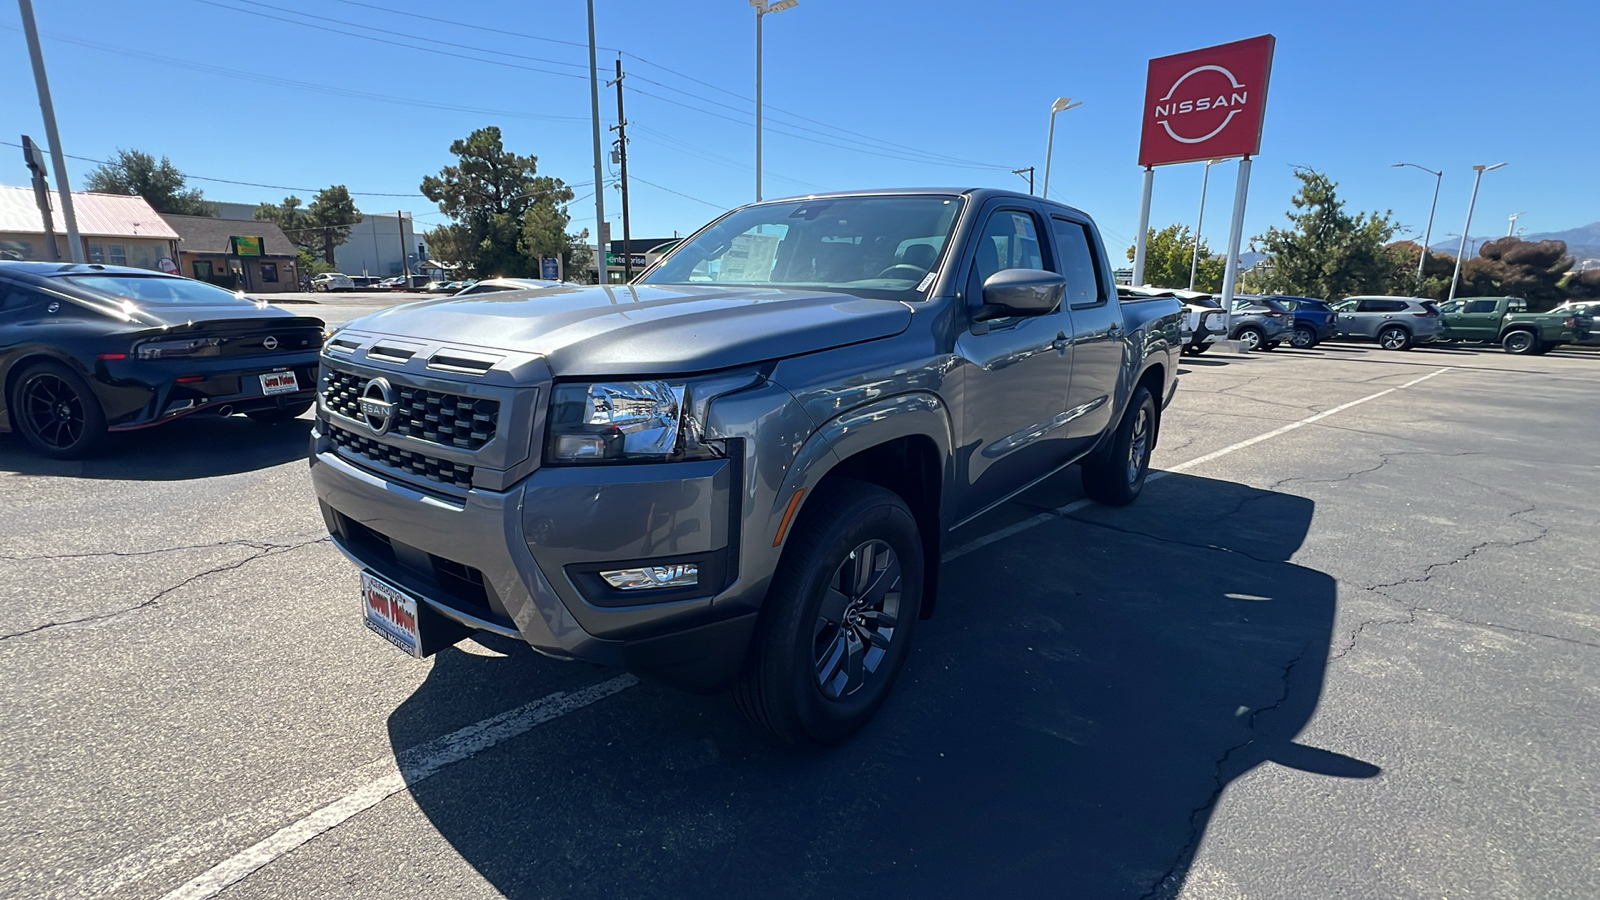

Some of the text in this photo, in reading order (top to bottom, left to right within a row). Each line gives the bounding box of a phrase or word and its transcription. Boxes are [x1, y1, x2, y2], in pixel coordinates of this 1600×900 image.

[1155, 91, 1247, 117] NISSAN
[607, 256, 645, 264] enterise
[362, 402, 390, 415] SSAN
[366, 620, 387, 639] CROWN
[387, 633, 414, 656] MOTORS
